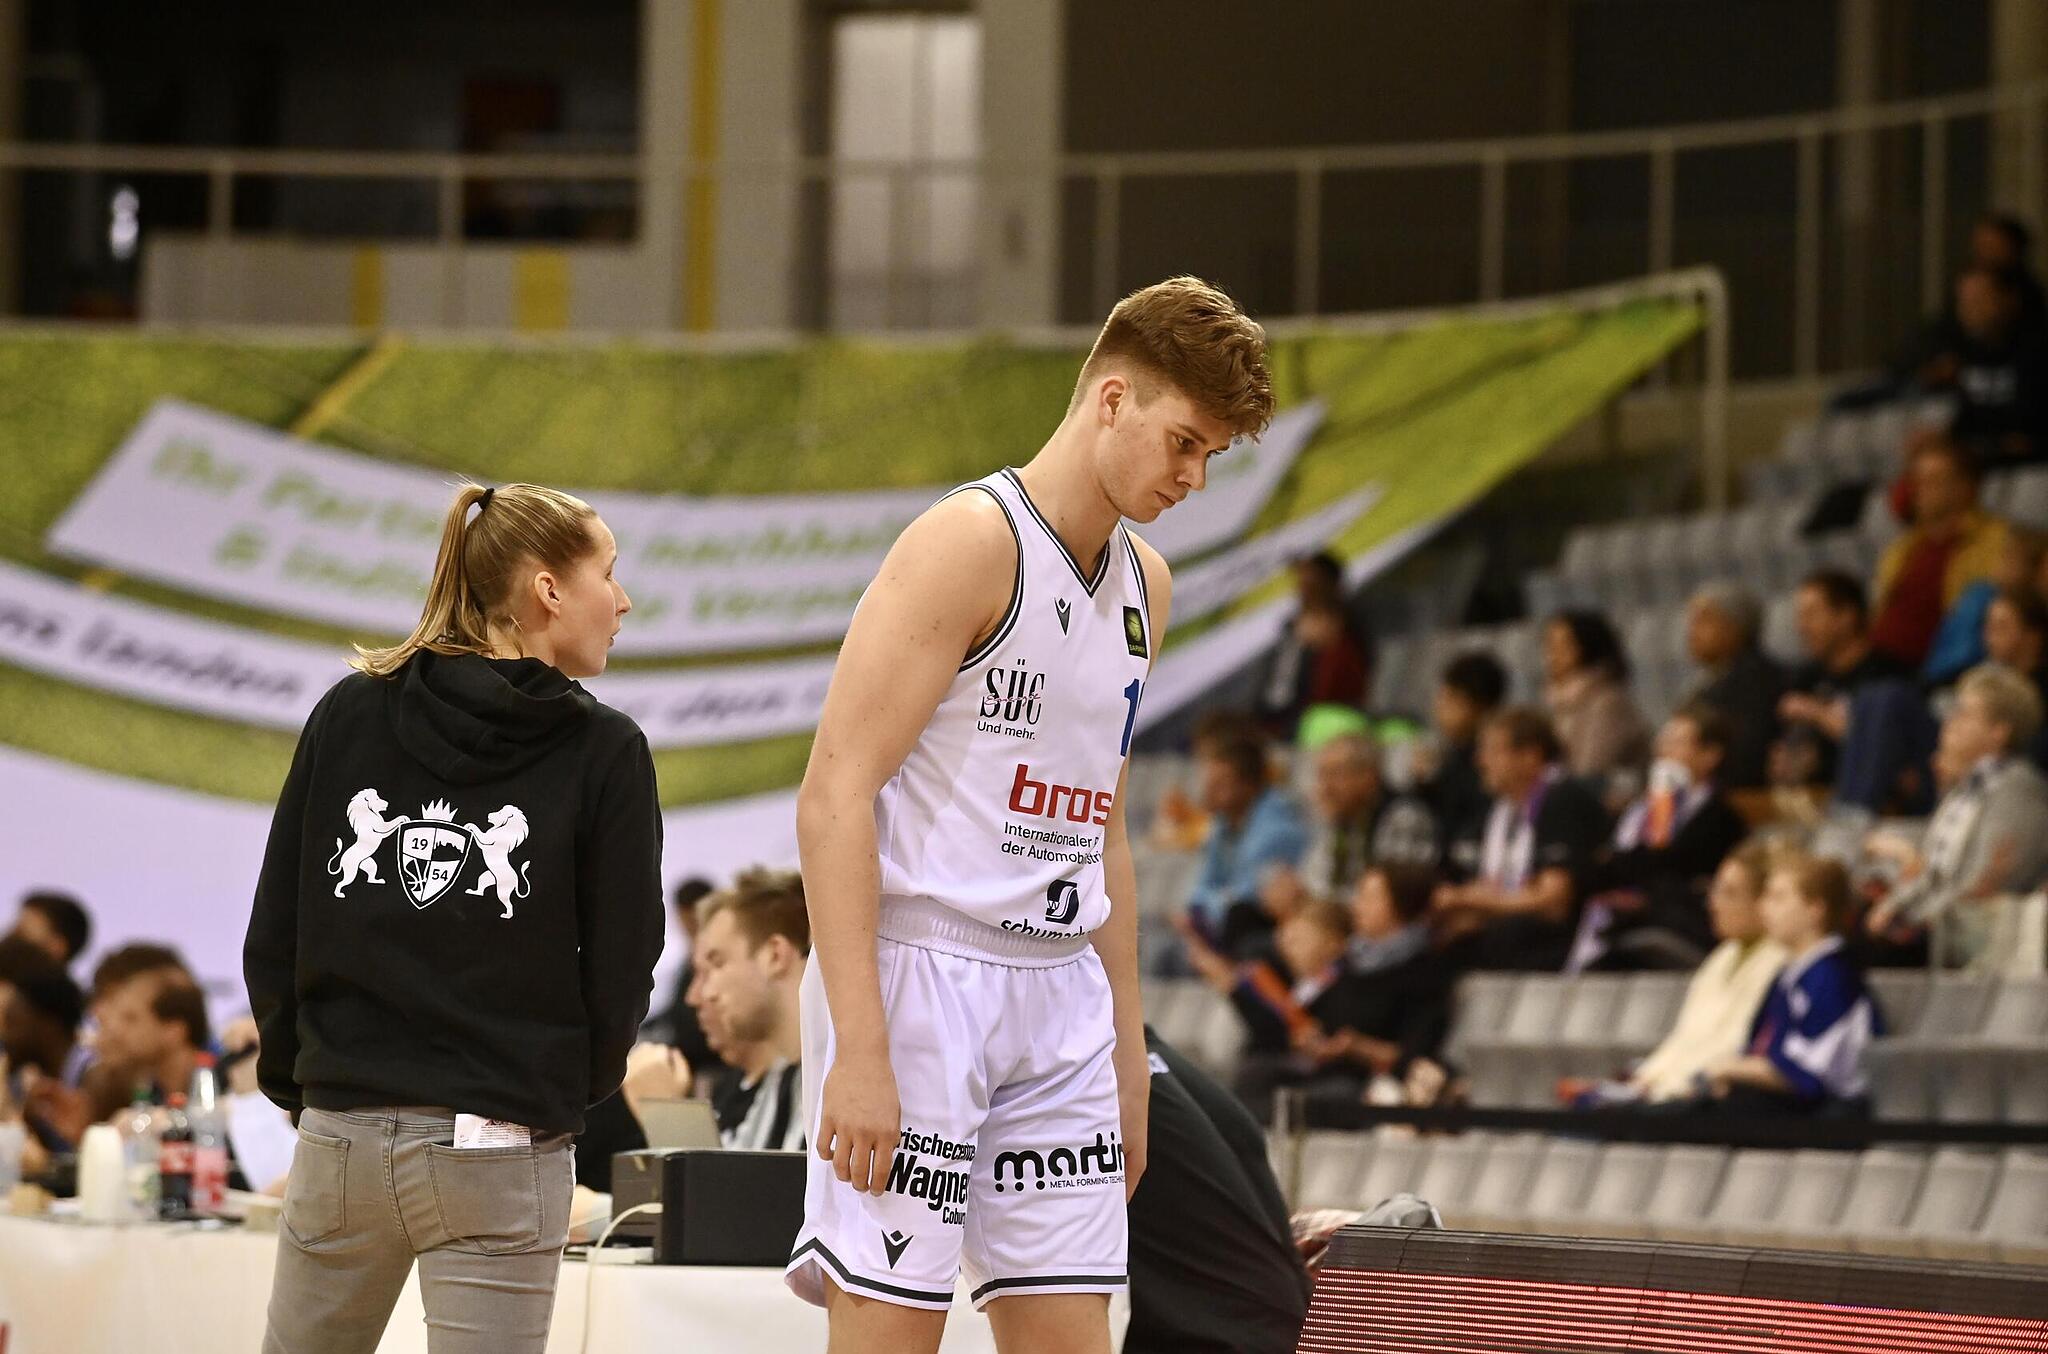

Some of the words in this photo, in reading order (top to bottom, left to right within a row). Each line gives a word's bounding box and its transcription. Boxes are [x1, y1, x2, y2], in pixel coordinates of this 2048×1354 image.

[980, 658, 1045, 725] SÜC
[977, 720, 1002, 735] Und
[1004, 726, 1036, 740] mehr.
[1008, 763, 1113, 826] bros
[411, 837, 428, 851] 19
[1004, 821, 1093, 848] Internationaler
[1001, 840, 1026, 857] der
[432, 868, 449, 882] 54
[885, 1152, 970, 1211] Wagne
[1050, 1179, 1076, 1189] METAL
[1076, 1176, 1109, 1187] FORMING
